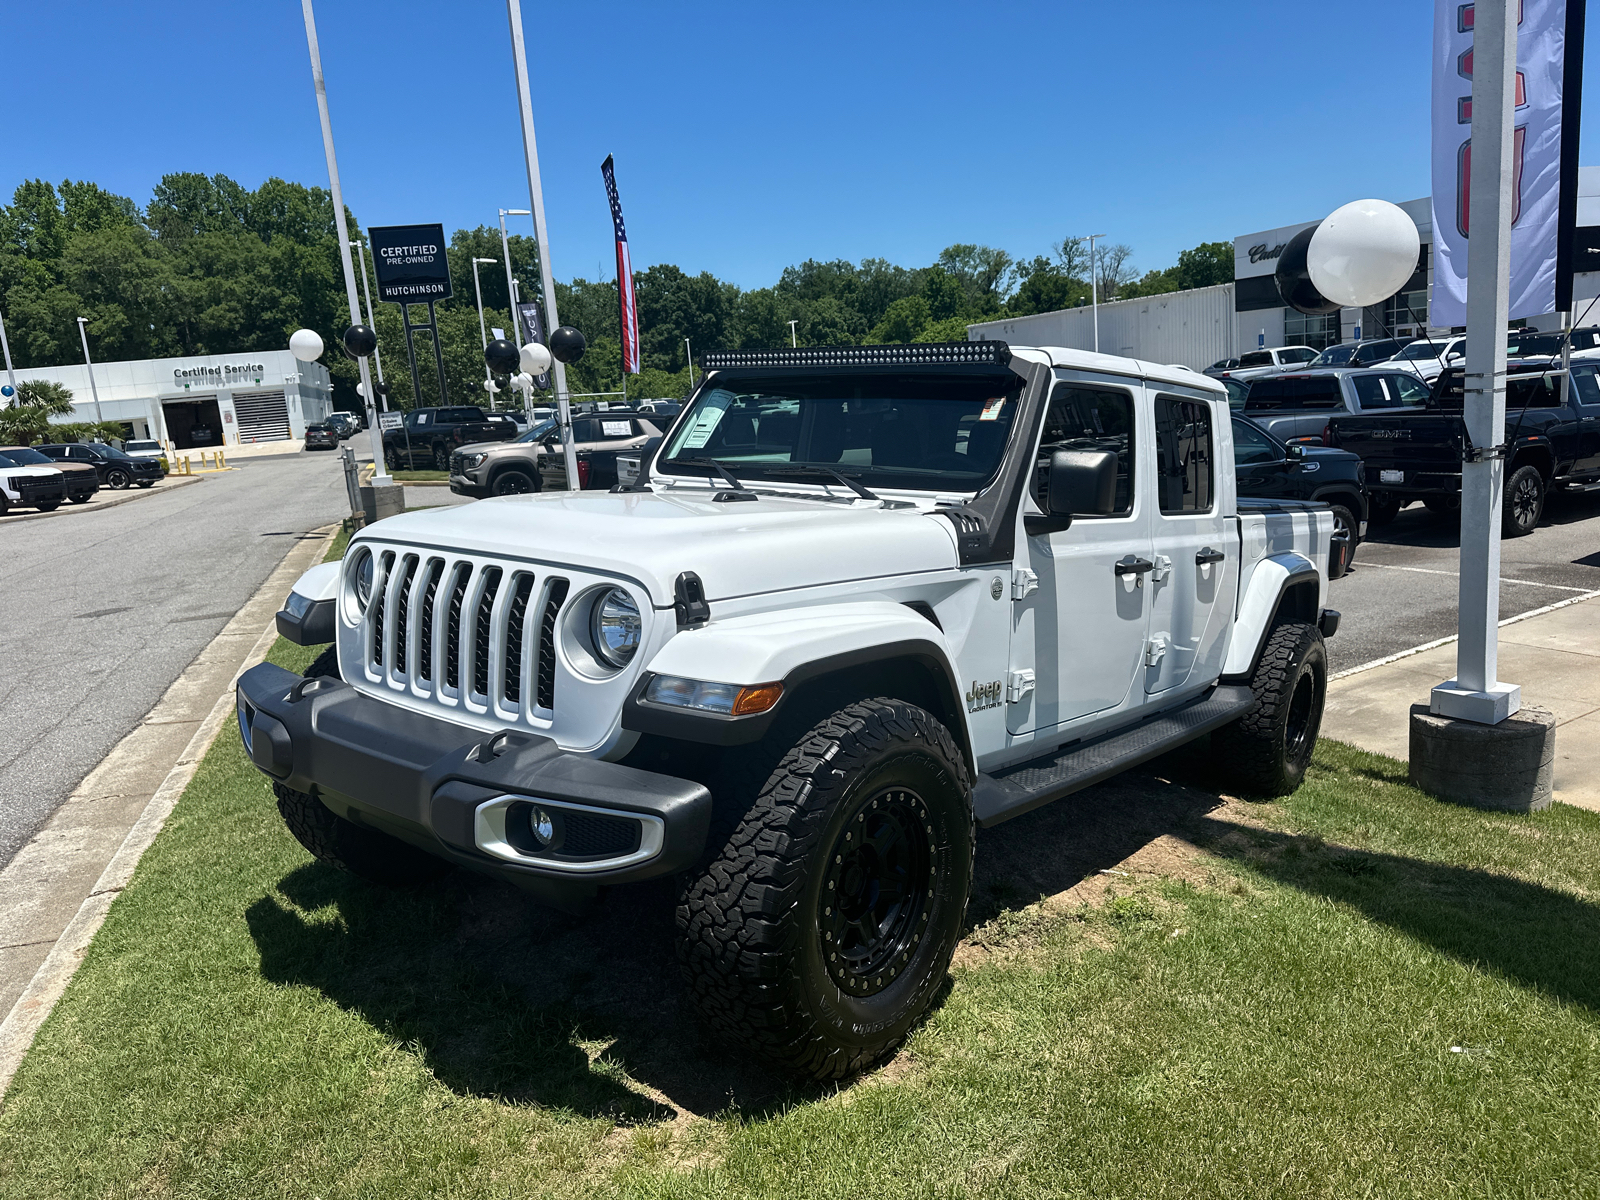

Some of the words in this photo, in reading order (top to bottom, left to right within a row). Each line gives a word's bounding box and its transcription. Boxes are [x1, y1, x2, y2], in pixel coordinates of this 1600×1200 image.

[380, 244, 438, 257] CERTIFIED
[1247, 243, 1286, 264] Cadil
[386, 255, 435, 265] PRE-OWNED
[385, 284, 444, 296] HUTCHINSON
[173, 365, 222, 378] Certified
[224, 362, 264, 374] Service
[1371, 429, 1412, 439] GMC
[966, 679, 1002, 703] Jeep
[967, 703, 996, 714] LADIATOR
